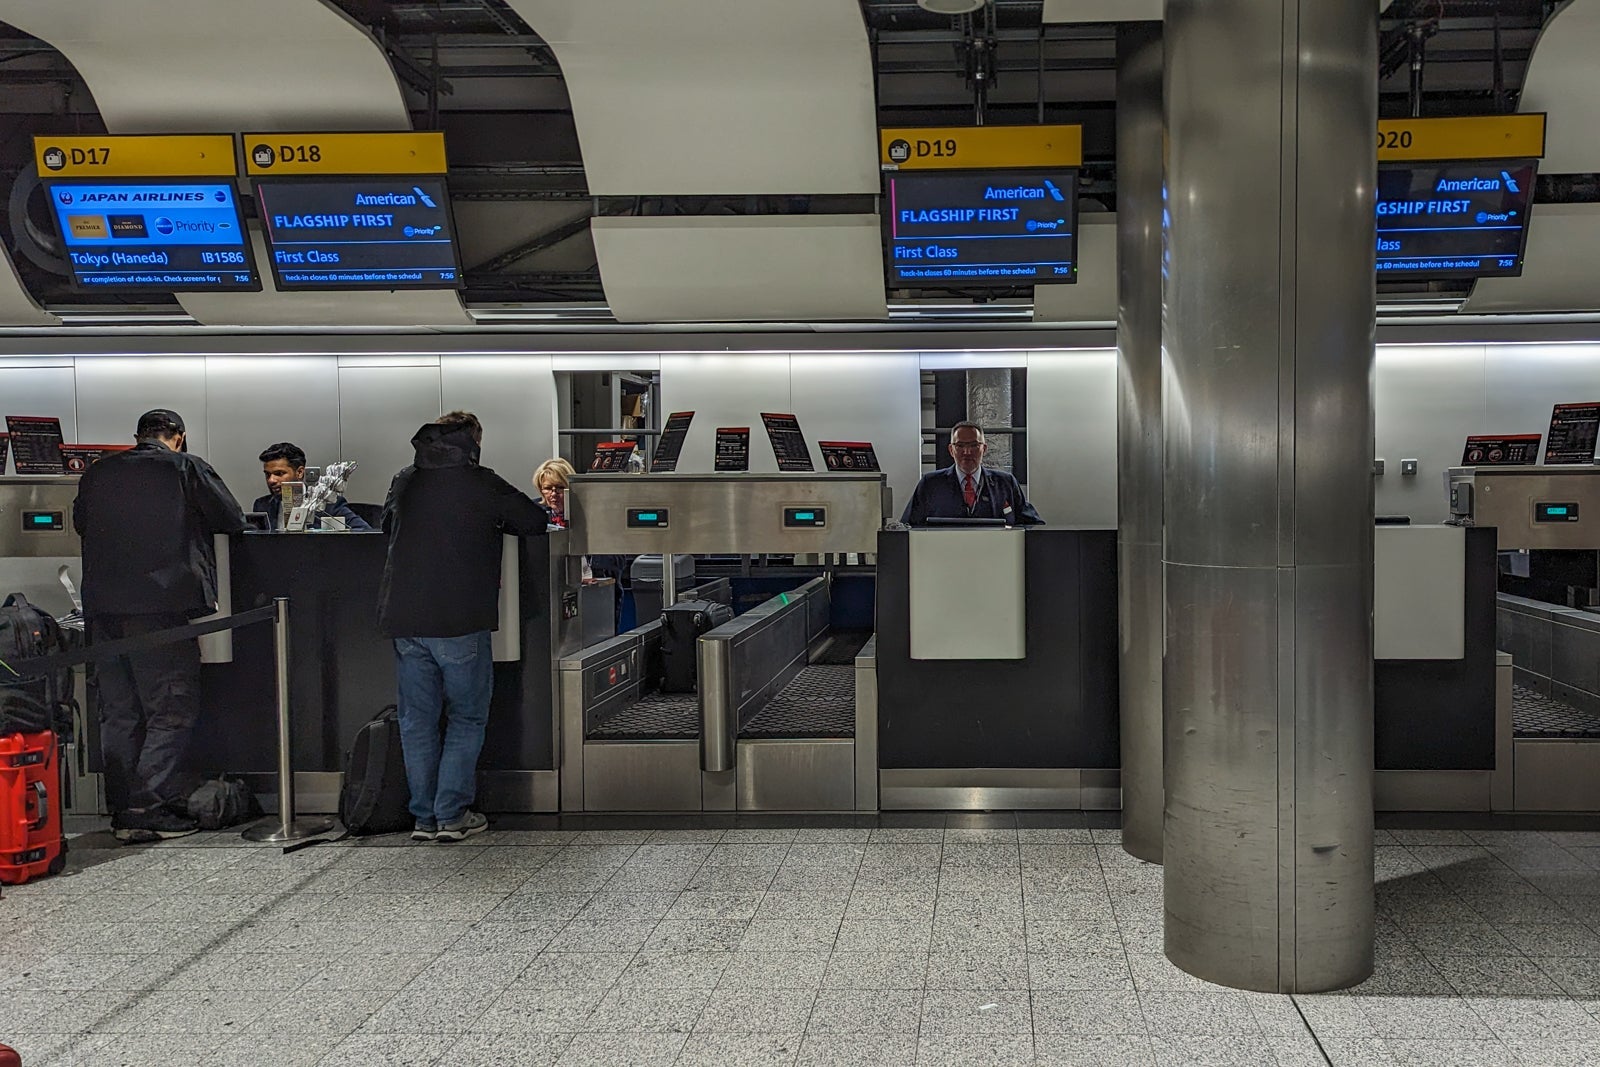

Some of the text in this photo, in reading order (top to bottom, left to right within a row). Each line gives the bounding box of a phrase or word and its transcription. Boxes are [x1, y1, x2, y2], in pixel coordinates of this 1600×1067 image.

[280, 145, 321, 163] D18
[916, 139, 957, 158] D19
[71, 148, 110, 165] D17
[1436, 178, 1500, 192] American
[80, 193, 129, 202] JAPAN
[132, 192, 205, 202] AIRLINES
[355, 193, 416, 206] American
[984, 186, 1045, 200] American
[1427, 200, 1470, 213] FIRST
[274, 214, 393, 228] FLAGSHIP FIRST
[901, 208, 1019, 222] FLAGSHIP FIRST
[1487, 213, 1508, 222] Priority
[175, 220, 215, 233] Priority
[414, 228, 434, 236] Priority
[1037, 221, 1057, 230] Priority
[201, 251, 244, 263] IB1586
[275, 250, 340, 263] First Class
[895, 245, 958, 258] First Class
[70, 251, 168, 267] Tokyo (Haneda)
[1392, 261, 1419, 269] minutes
[1442, 260, 1454, 268] the
[91, 275, 127, 284] completion
[127, 275, 134, 283] of
[135, 275, 163, 283] check-in.
[338, 273, 363, 281] minutes
[440, 272, 454, 280] 7:56
